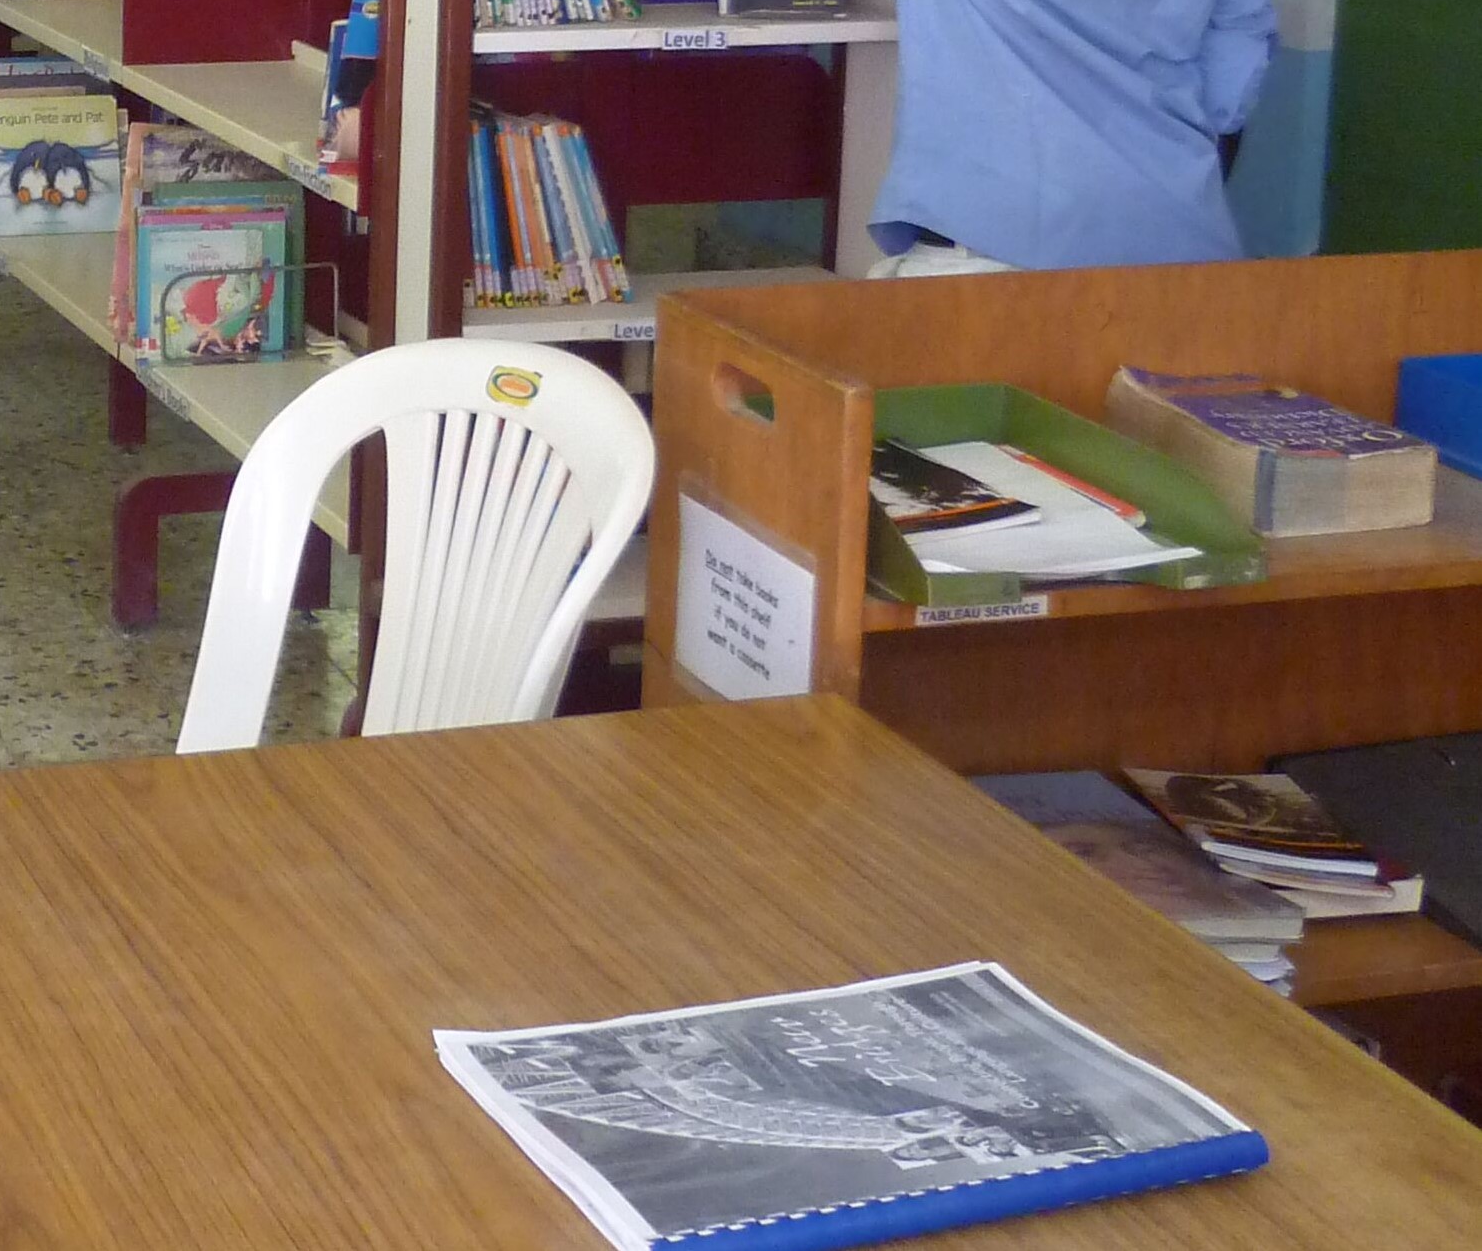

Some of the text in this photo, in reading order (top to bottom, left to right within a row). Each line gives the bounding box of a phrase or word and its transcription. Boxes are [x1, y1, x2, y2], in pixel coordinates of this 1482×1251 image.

[664, 30, 726, 48] Level 3
[35, 113, 59, 124] Pete
[62, 111, 83, 124] and
[86, 111, 105, 123] Pat
[613, 323, 654, 339] Leve
[705, 549, 718, 567] Do
[719, 562, 735, 577] not
[711, 577, 732, 602] from
[733, 591, 749, 614] this
[921, 602, 1040, 622] TABLEAU SERVICE
[724, 613, 739, 632] you
[741, 624, 751, 640] do
[752, 634, 767, 650] not
[707, 629, 728, 648] want
[737, 648, 771, 681] cassette
